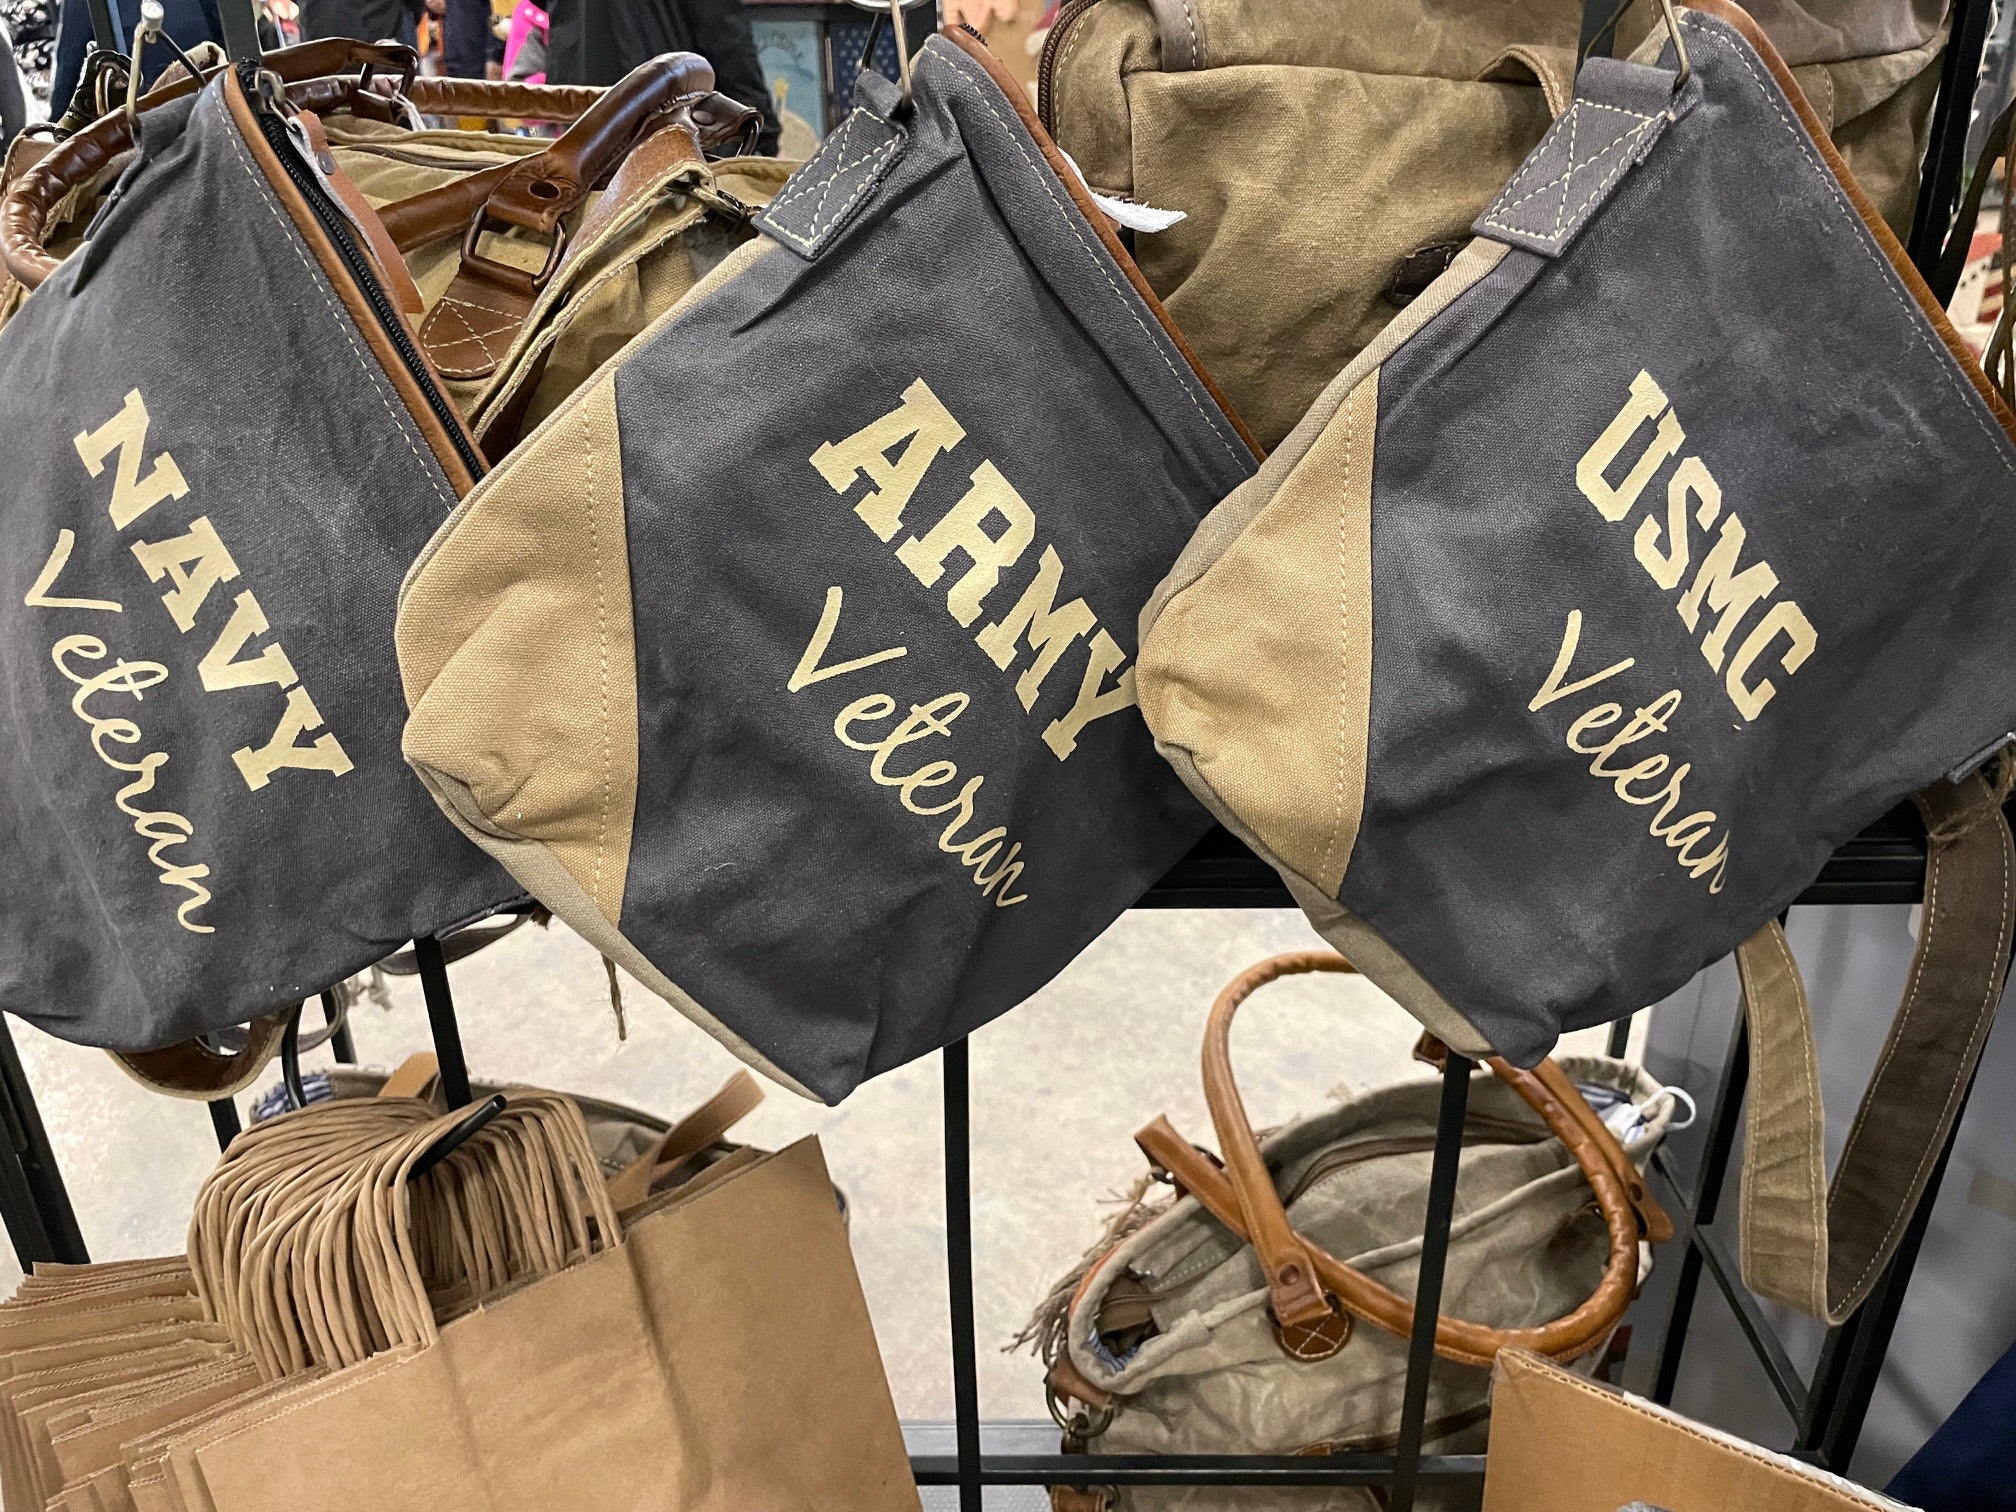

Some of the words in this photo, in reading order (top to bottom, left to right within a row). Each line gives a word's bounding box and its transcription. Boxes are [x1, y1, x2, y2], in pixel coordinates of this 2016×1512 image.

[73, 388, 354, 792] NAVY
[809, 377, 1138, 762] ARMY
[1576, 369, 1818, 722] USMC
[24, 528, 216, 934] Veteran
[787, 586, 1029, 907] Veteran
[1527, 609, 1730, 894] Veteran
